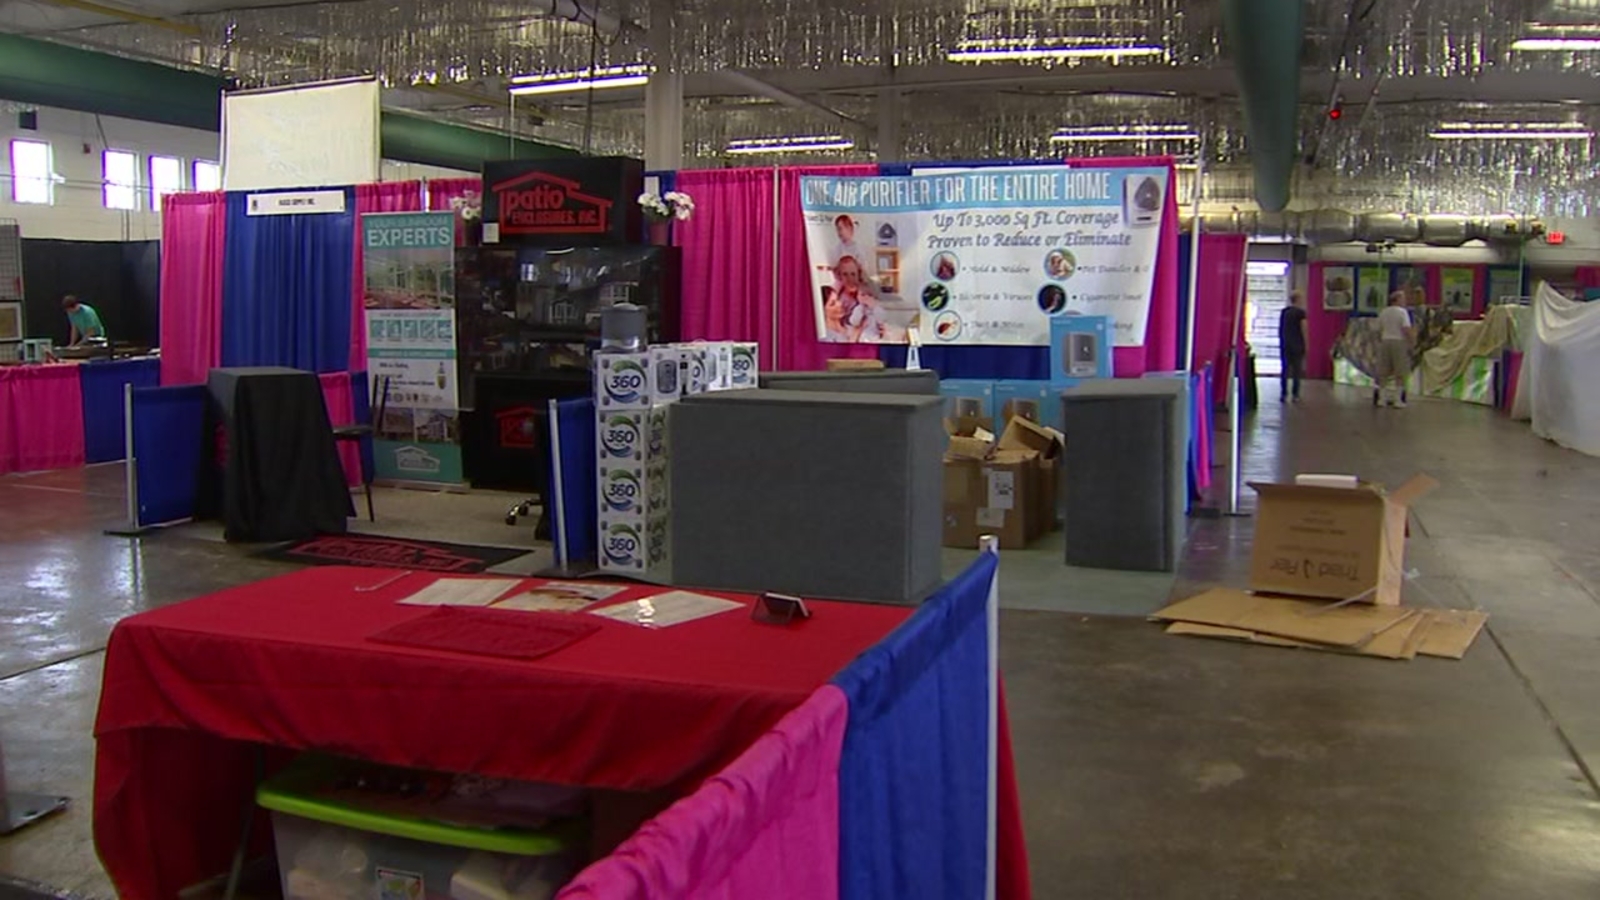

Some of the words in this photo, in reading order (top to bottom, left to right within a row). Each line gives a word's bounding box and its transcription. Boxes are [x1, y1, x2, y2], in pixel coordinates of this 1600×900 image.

[806, 180, 831, 205] ONE
[834, 180, 858, 207] AIR
[860, 179, 930, 207] PURIFIER
[935, 176, 965, 203] FOR
[970, 175, 999, 202] THE
[1004, 173, 1059, 201] ENTIRE
[1065, 172, 1111, 200] HOME
[506, 184, 565, 220] patio
[933, 213, 953, 231] Up
[956, 212, 972, 226] To
[975, 213, 1011, 228] 3,000
[1013, 211, 1029, 229] Sq
[1056, 210, 1119, 229] Coverage
[367, 226, 451, 247] EXPERTS
[927, 235, 973, 248] Proven
[976, 234, 992, 247] to
[993, 231, 1041, 247] Reduce
[1044, 235, 1059, 246] or
[1064, 230, 1131, 247] Eliminate
[610, 374, 642, 389] 360
[607, 430, 634, 443] 360
[608, 483, 635, 497] 360
[608, 537, 635, 551] 360
